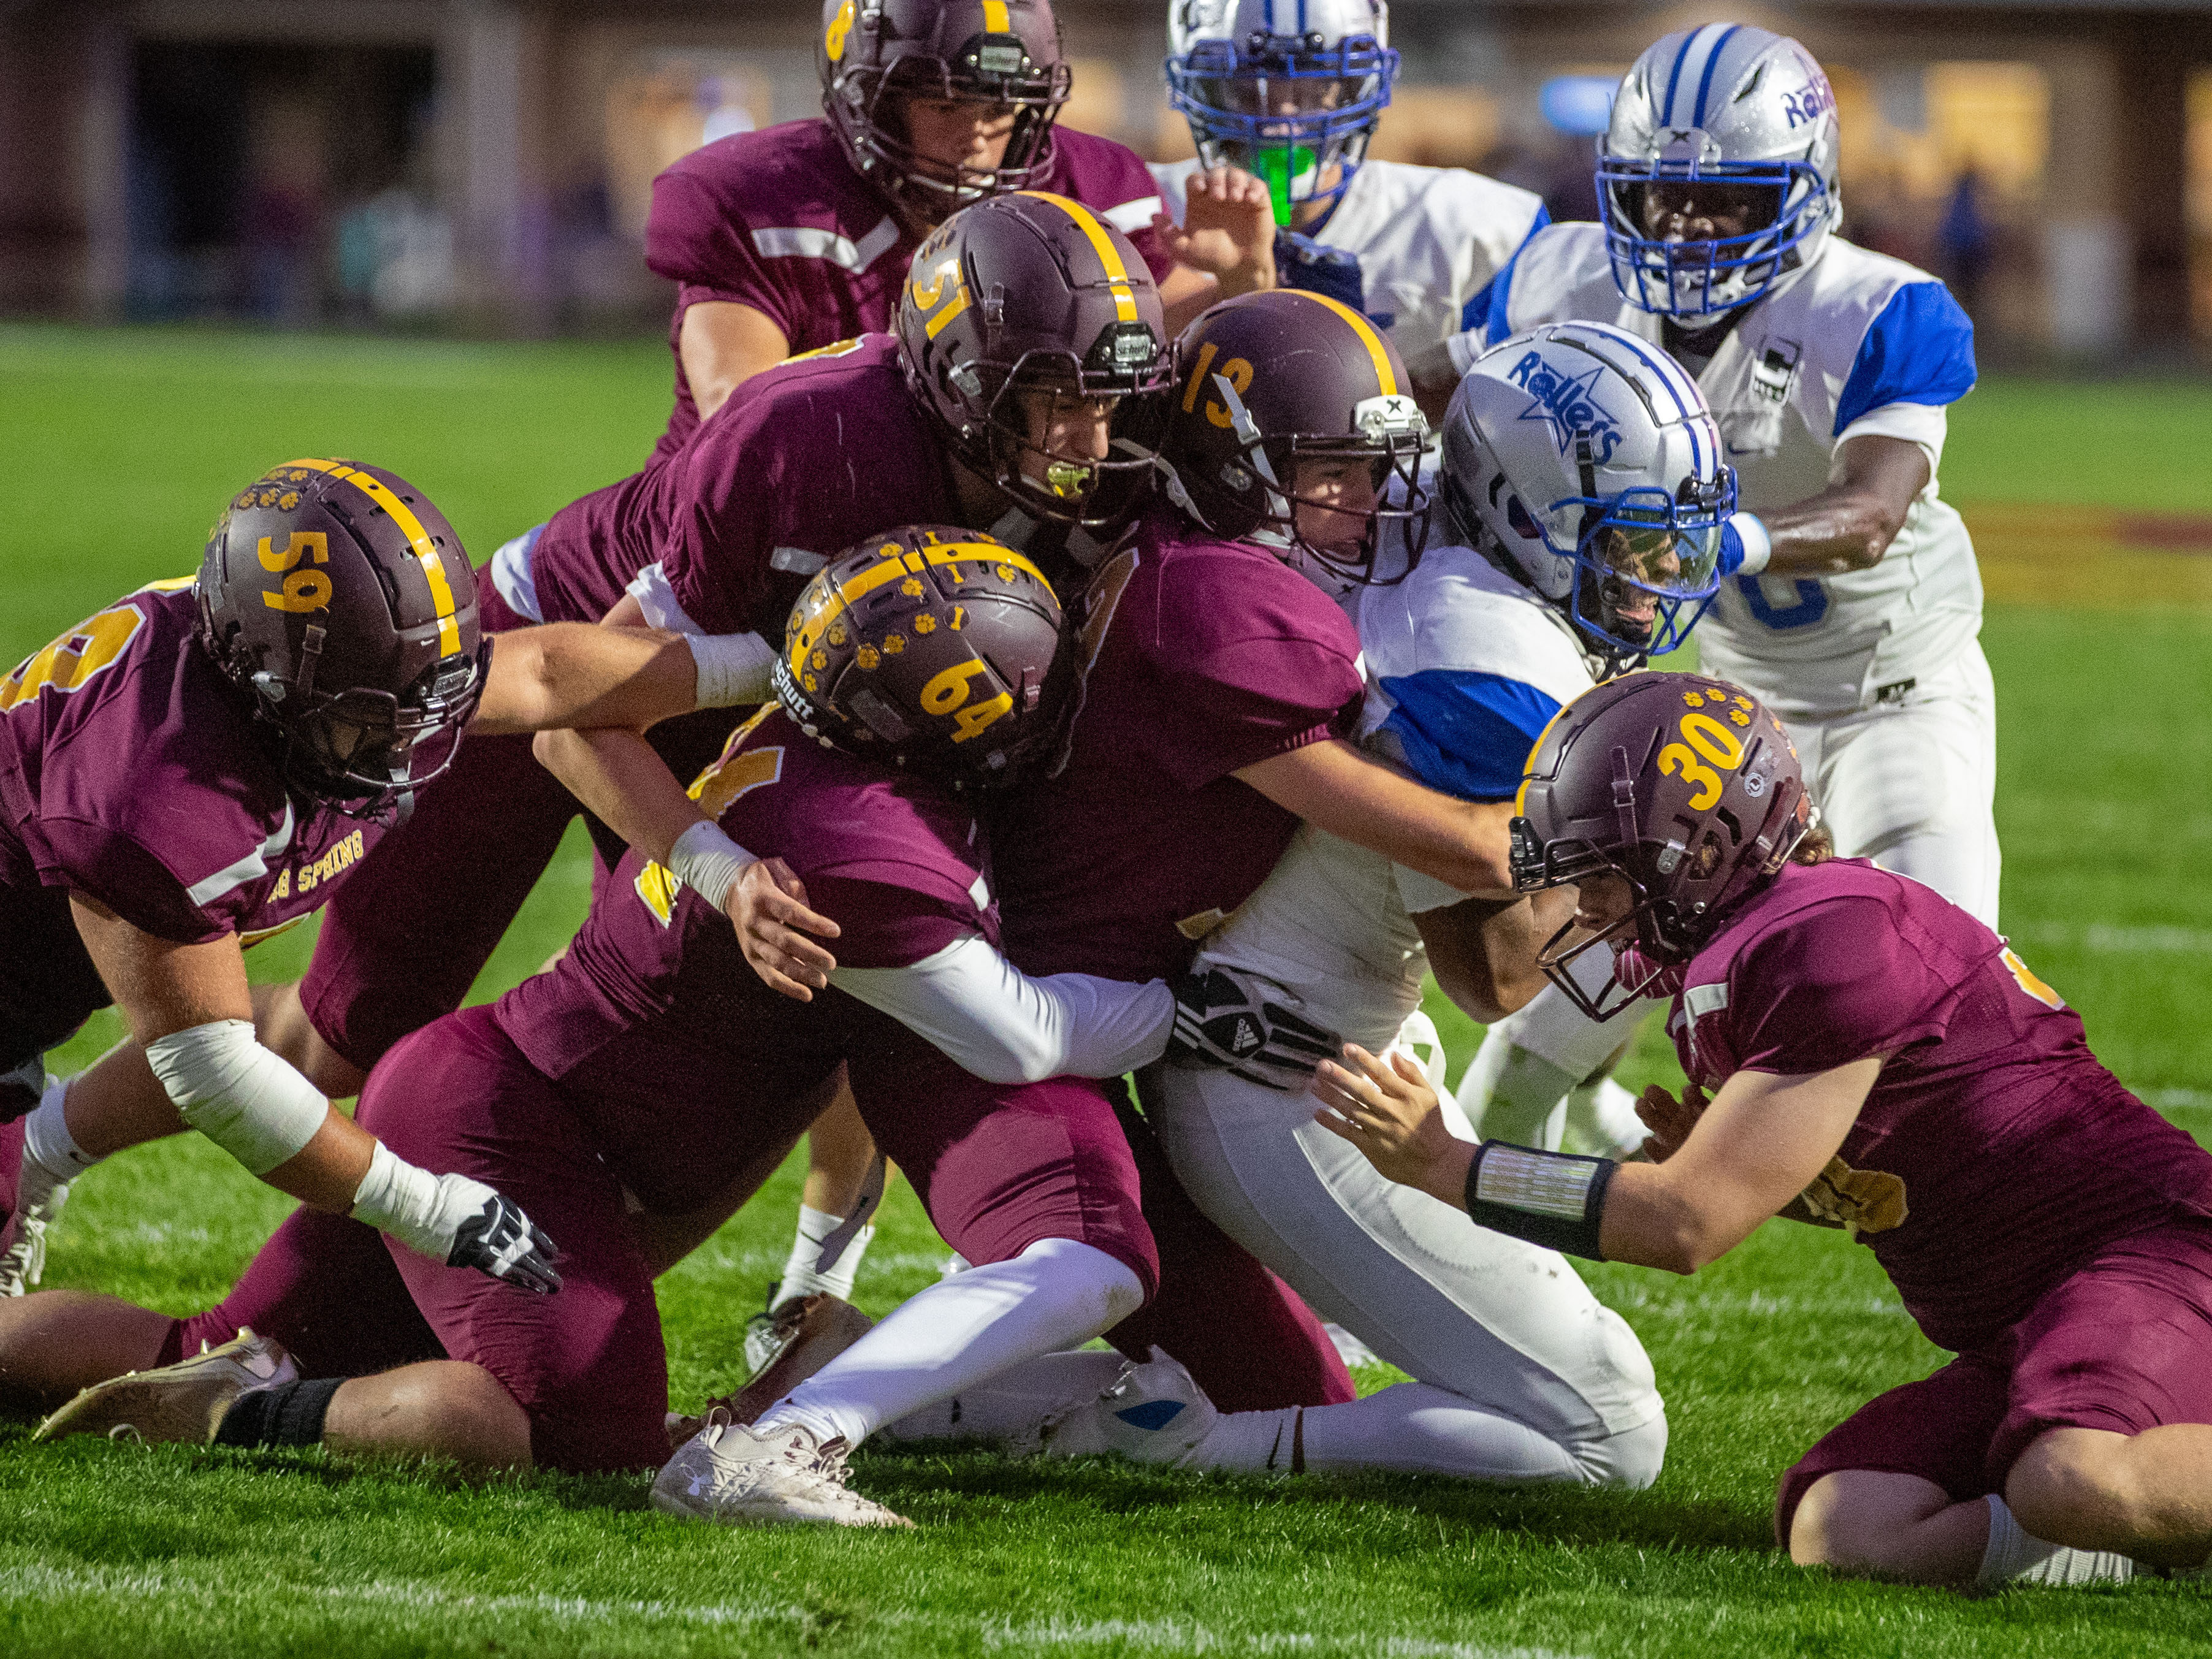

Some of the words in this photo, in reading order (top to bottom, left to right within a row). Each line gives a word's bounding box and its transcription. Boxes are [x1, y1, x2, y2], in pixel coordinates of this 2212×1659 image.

[913, 257, 972, 340] 51
[1507, 350, 1623, 466] Rollers
[257, 531, 333, 613] 59
[775, 657, 814, 720] schutt
[920, 658, 1013, 744] 64
[1657, 712, 1745, 811] 30
[297, 829, 364, 893] SPRING
